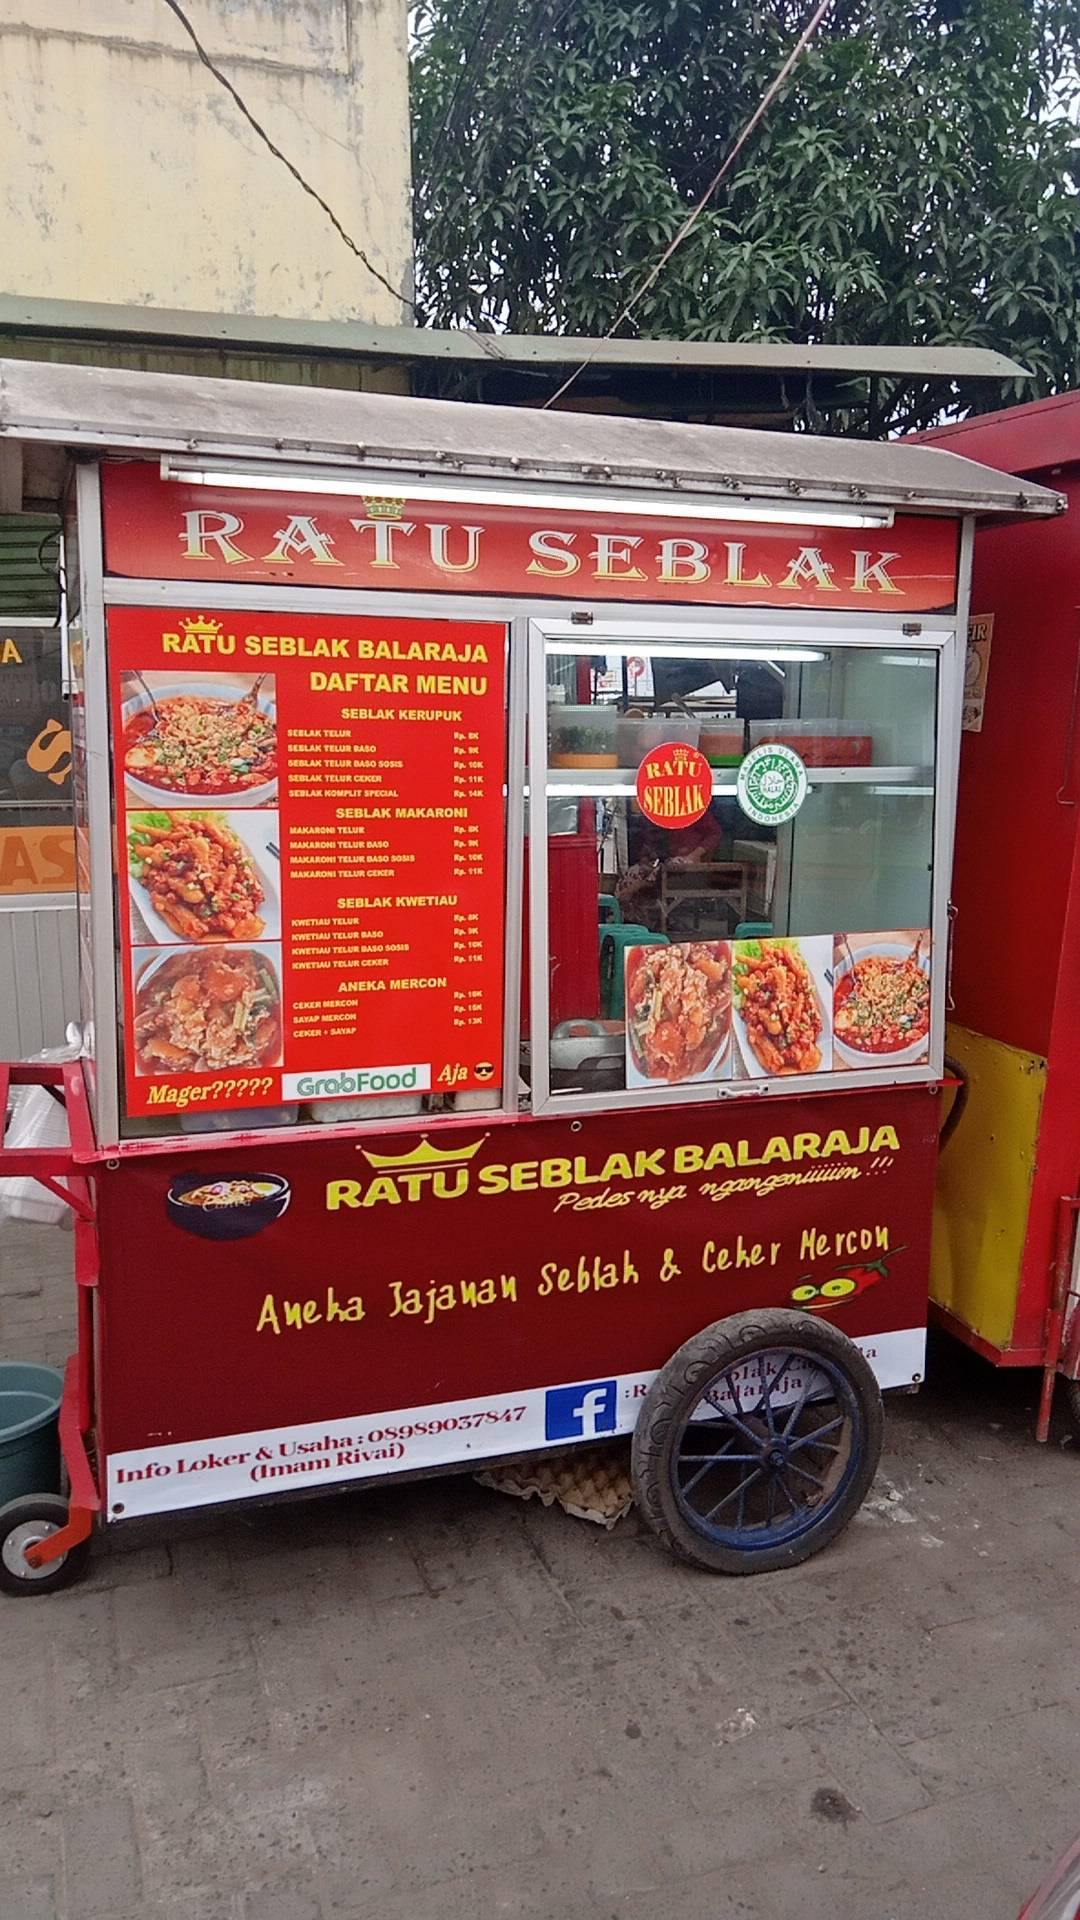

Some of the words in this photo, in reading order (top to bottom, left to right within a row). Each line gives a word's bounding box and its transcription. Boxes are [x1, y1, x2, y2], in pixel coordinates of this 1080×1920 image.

[178, 509, 486, 573] RATU
[525, 530, 906, 595] SEBLAK
[163, 633, 235, 654] RATU
[245, 636, 349, 657] SEBLAK
[359, 640, 488, 662] BALARAJA
[311, 672, 408, 692] DAFTAR
[417, 676, 486, 695] MENU
[342, 709, 394, 719] SEBLAK
[399, 710, 461, 721] KERUPUK
[288, 729, 321, 737] SEBLAK
[454, 732, 466, 740] Rp.
[454, 747, 466, 755] Rp.
[454, 761, 466, 769] Rp.
[646, 761, 702, 780] RATU
[454, 776, 466, 784] Rp.
[454, 790, 466, 798] Rp.
[644, 785, 705, 818] SEBLAK
[336, 808, 391, 818] SEBLAK
[396, 808, 467, 818] MAKARONI
[454, 826, 465, 834] Rp.
[454, 840, 466, 848] Rp.
[454, 854, 466, 862] Rp.
[454, 868, 466, 876] Rp.
[338, 897, 392, 908] SEBLAK
[396, 895, 457, 906] KWETIAU
[454, 928, 466, 936] Rp.
[292, 947, 330, 955] KWETIAU
[339, 981, 386, 992] ANEKA
[390, 977, 446, 989] MERCON
[437, 1065, 468, 1084] Aja
[297, 1068, 416, 1097] GrabFood
[326, 1168, 469, 1210] RATU
[478, 1149, 666, 1195] SEBLAK
[674, 1125, 901, 1174] BALARAJA
[553, 1187, 631, 1213] Pedes
[637, 1185, 688, 1210] nya
[256, 1287, 365, 1335] Aneka
[388, 1275, 517, 1324] Jajanan
[538, 1249, 639, 1296] Seblak
[660, 1248, 681, 1282] &
[702, 1235, 781, 1273] Ceker
[800, 1226, 888, 1260] Mercon
[116, 1462, 170, 1484] Info
[177, 1450, 250, 1475] Loker
[255, 1445, 274, 1461] &
[279, 1433, 352, 1457] Usaha
[367, 1406, 527, 1443] 08989037847
[250, 1459, 331, 1483] (Imam
[336, 1443, 405, 1468] Rivai)
